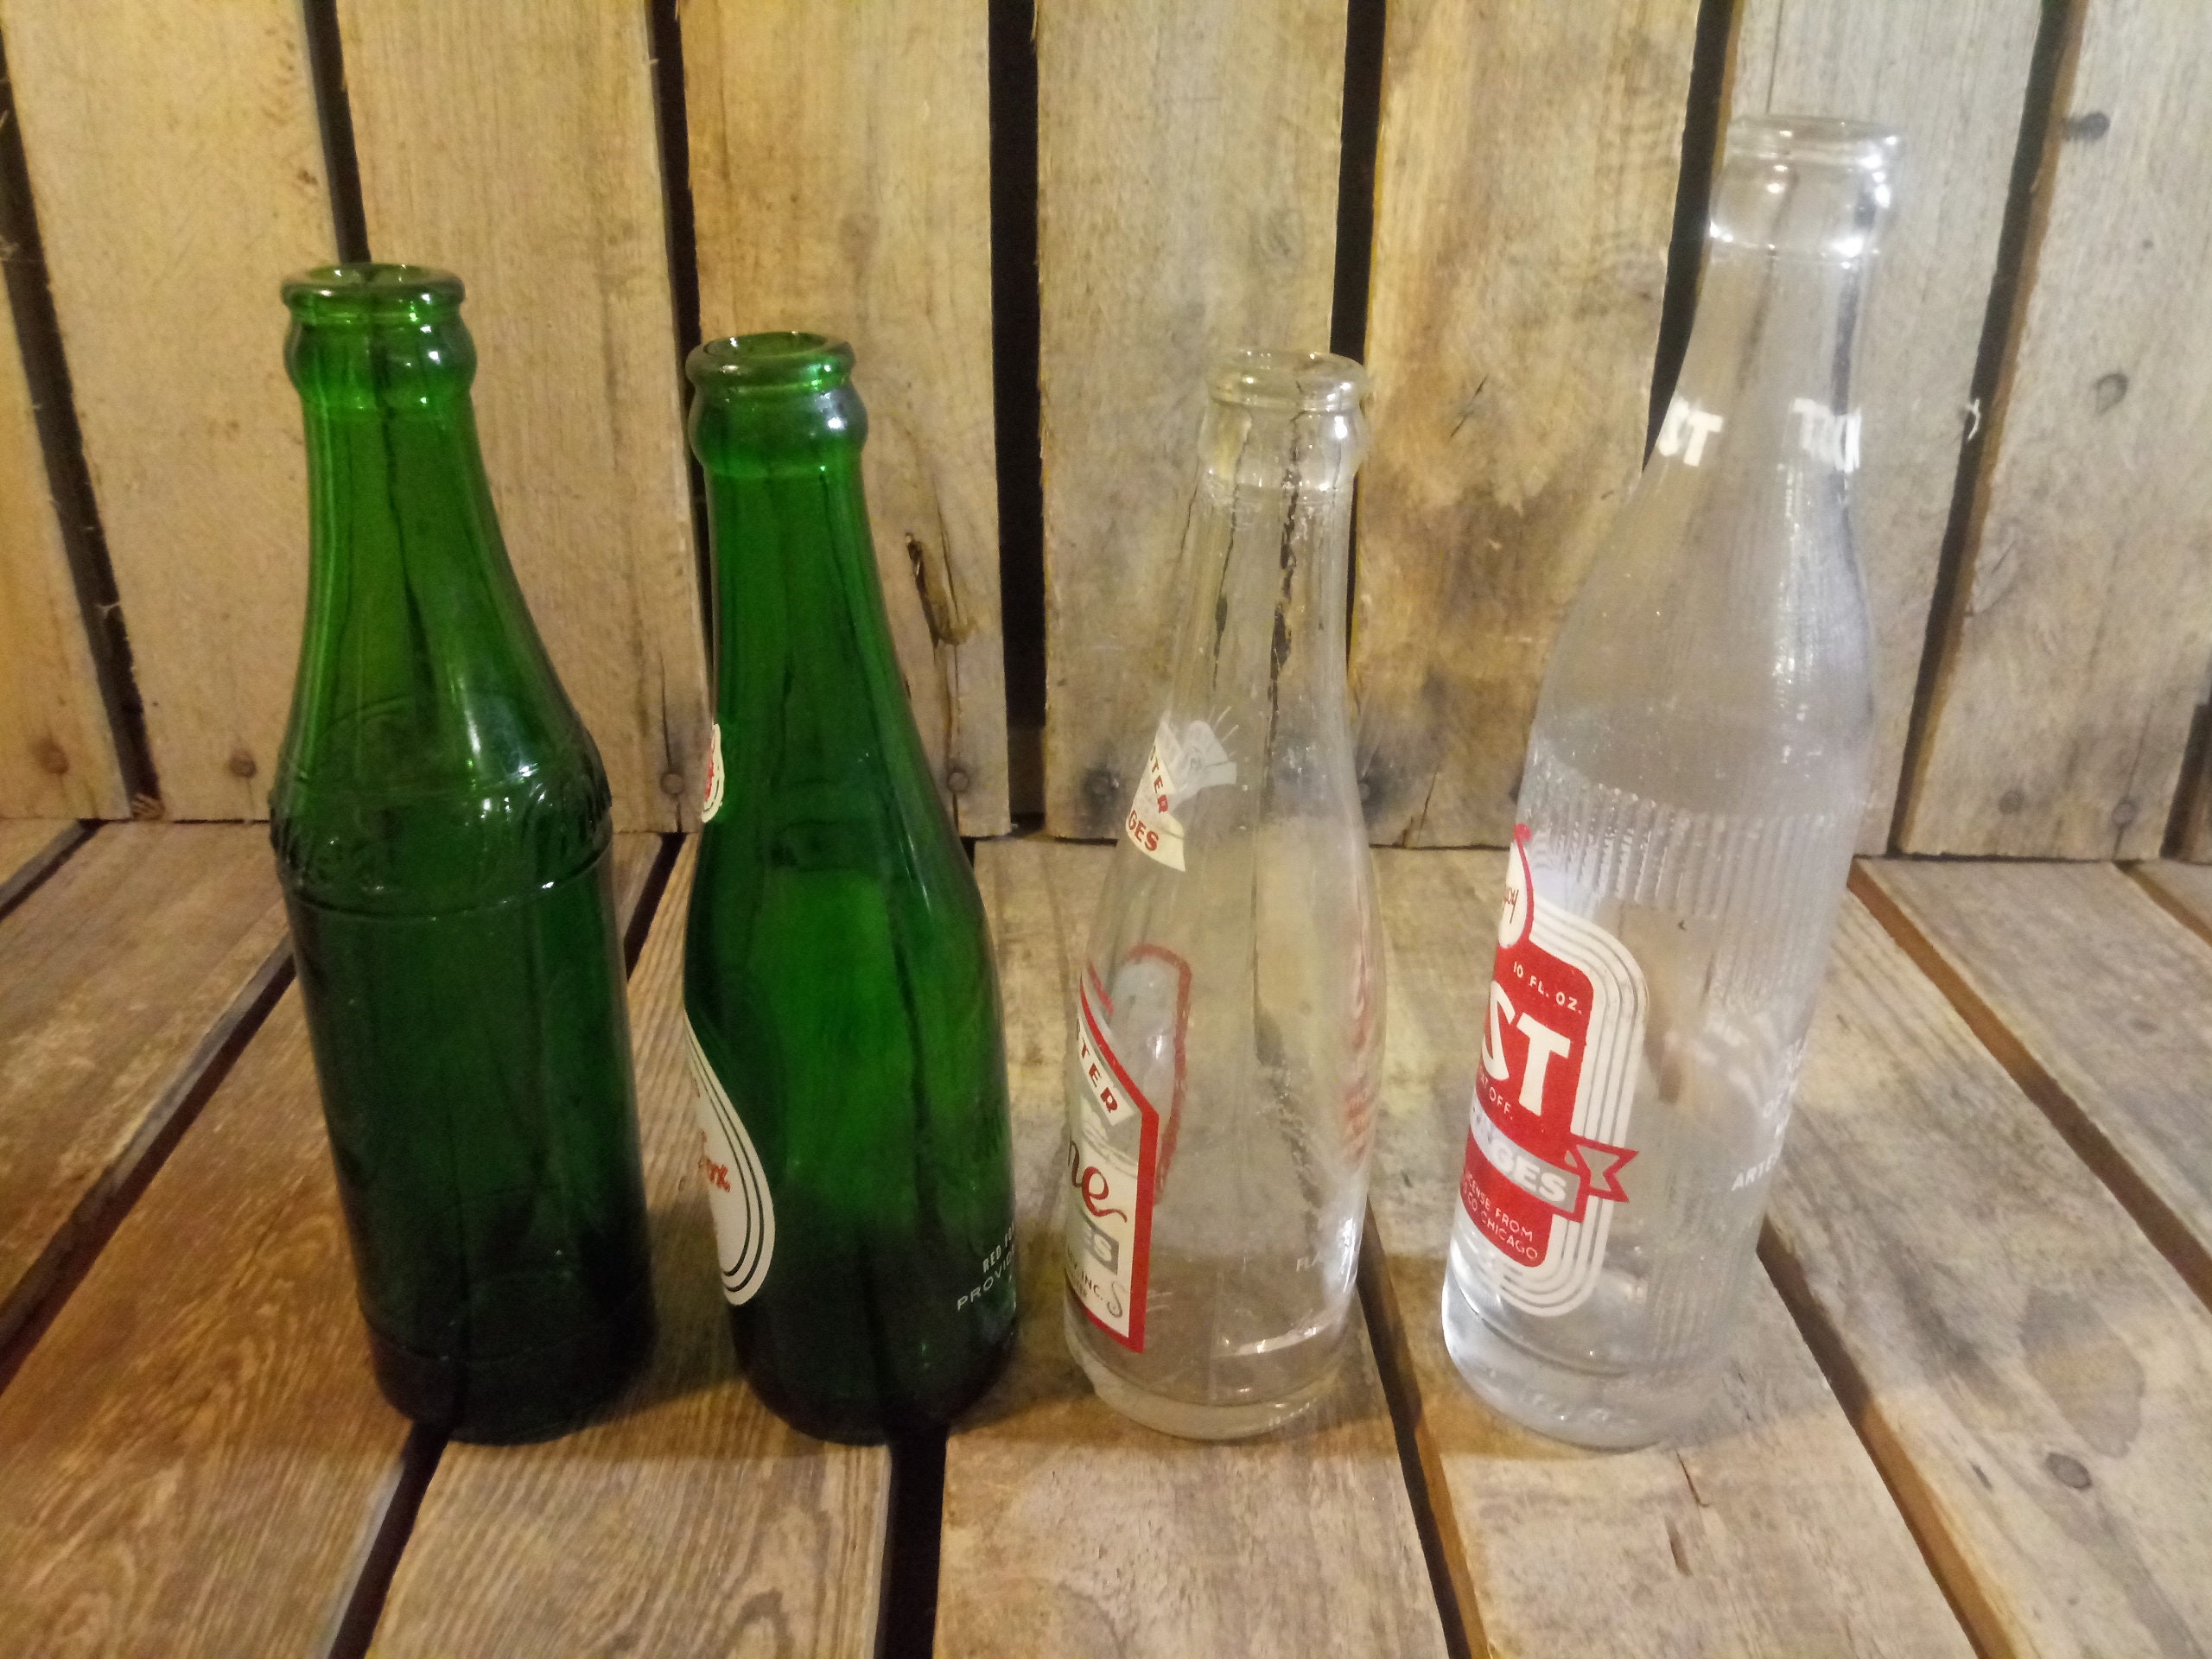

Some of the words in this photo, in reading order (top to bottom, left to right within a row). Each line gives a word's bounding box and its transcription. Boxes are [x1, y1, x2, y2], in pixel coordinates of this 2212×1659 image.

[1513, 961, 1524, 979] 10
[1529, 975, 1550, 998] FL.
[1555, 991, 1583, 1015] OZ.
[1489, 1086, 1514, 1121] OFF.
[1480, 1211, 1539, 1261] CHICAGO
[1495, 1207, 1534, 1243] FROM
